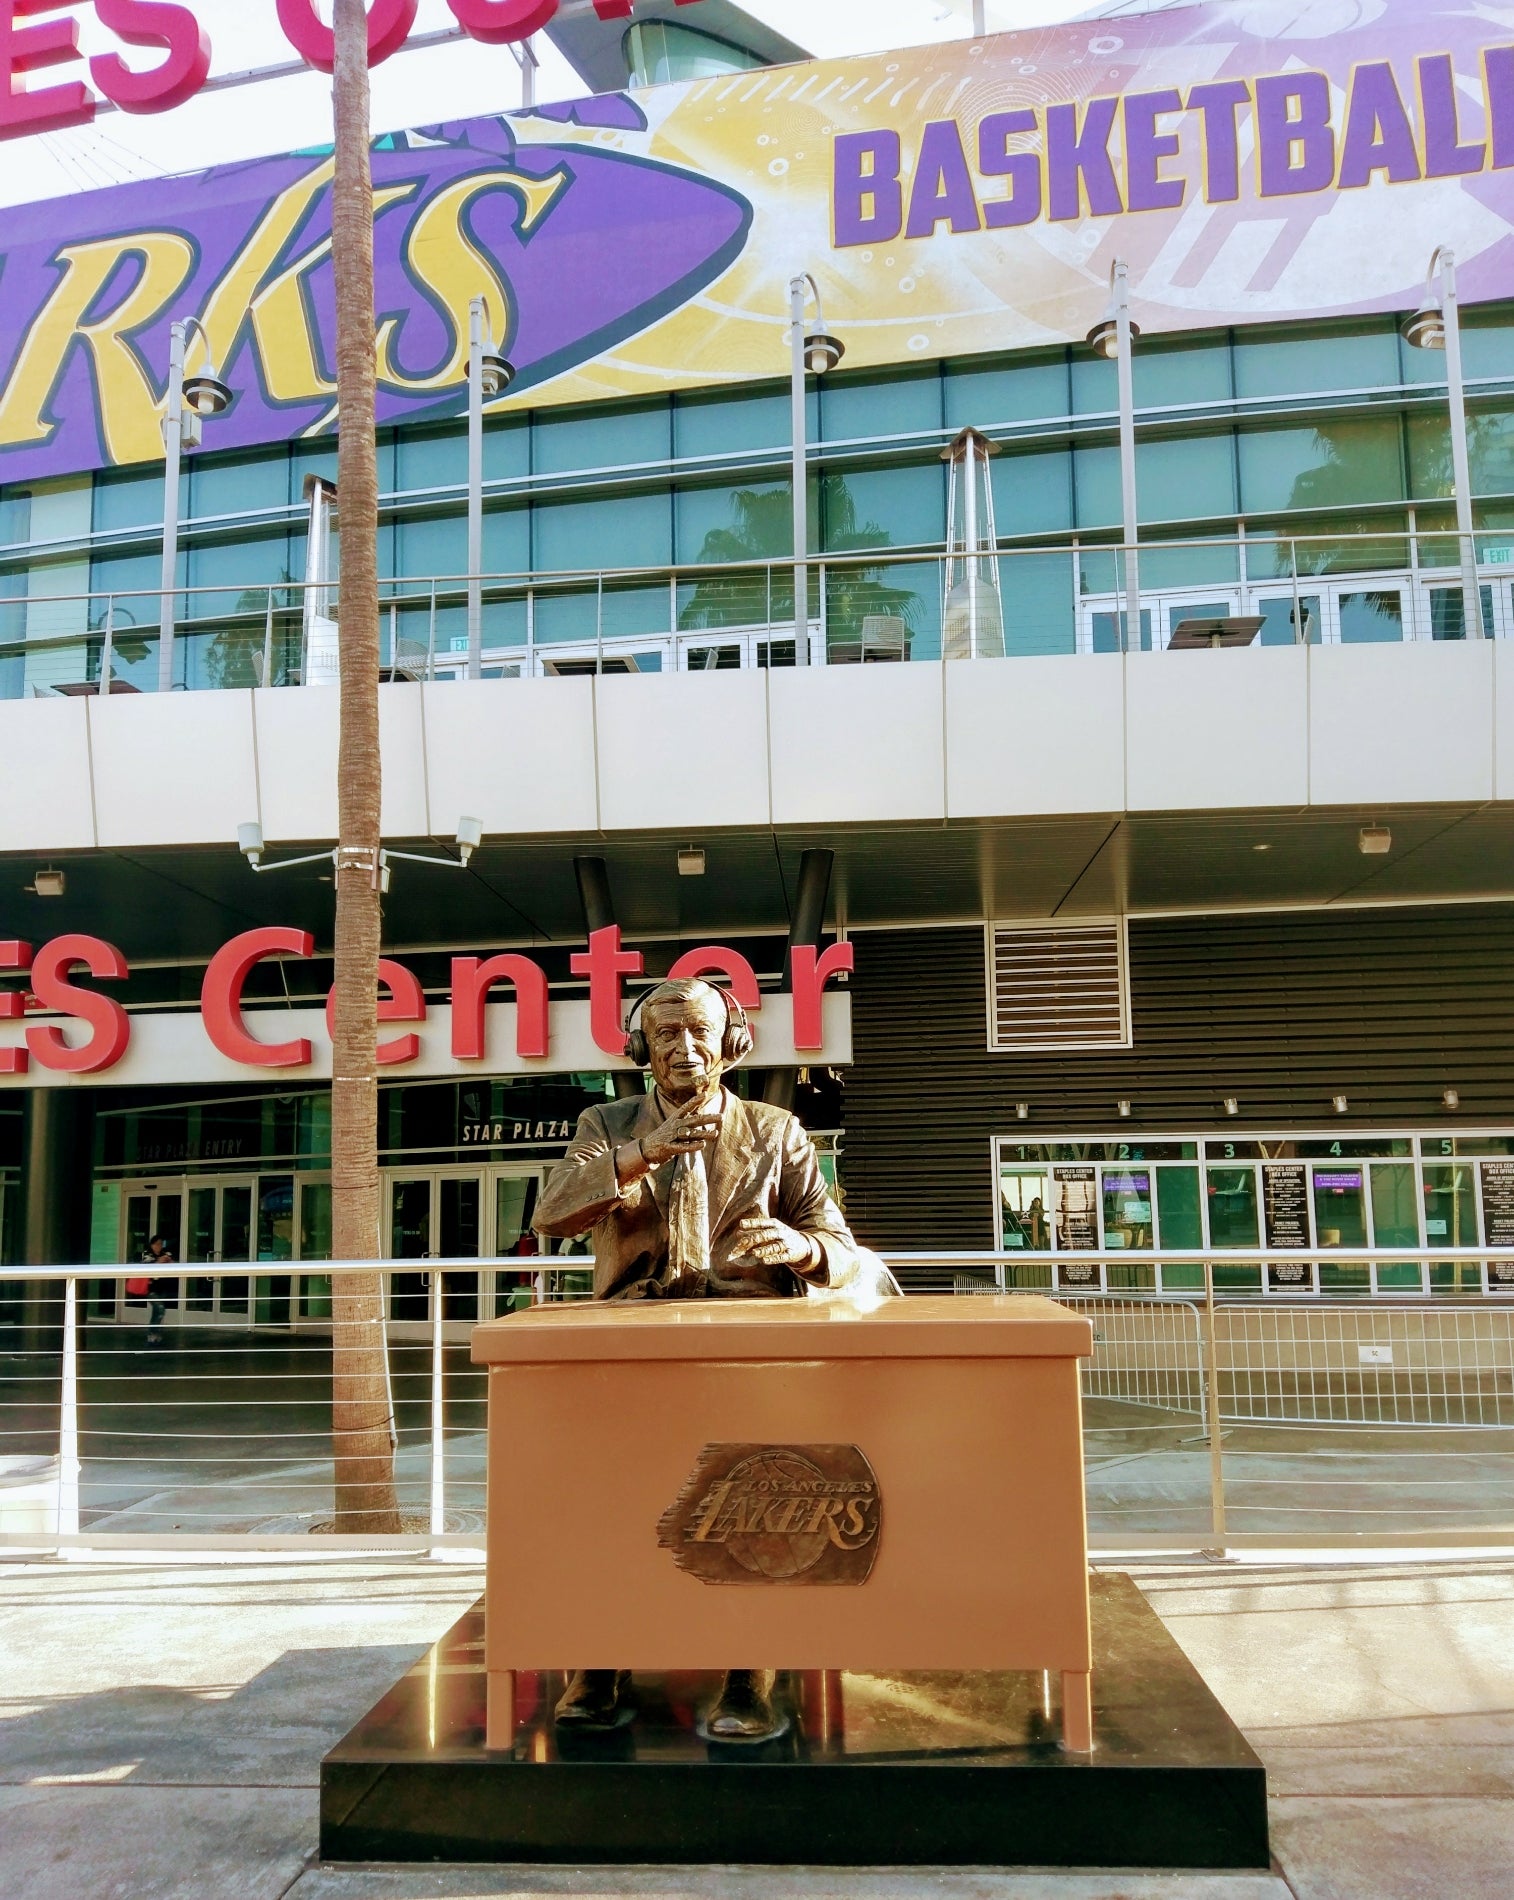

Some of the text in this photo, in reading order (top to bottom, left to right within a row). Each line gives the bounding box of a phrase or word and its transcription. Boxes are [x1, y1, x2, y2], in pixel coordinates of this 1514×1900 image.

[832, 44, 1514, 249] BASKETBALL
[1489, 548, 1511, 564] EXIT
[463, 1120, 569, 1141] STAR PLAZA
[205, 1139, 242, 1156] ENTRY
[1017, 1145, 1025, 1160] 1
[1119, 1144, 1130, 1159] 2
[1224, 1143, 1235, 1158] 3
[1330, 1141, 1342, 1156] 4
[1441, 1140, 1452, 1154] 5
[743, 1479, 876, 1493] LOS ANGELES
[684, 1480, 878, 1550] LAKERS
